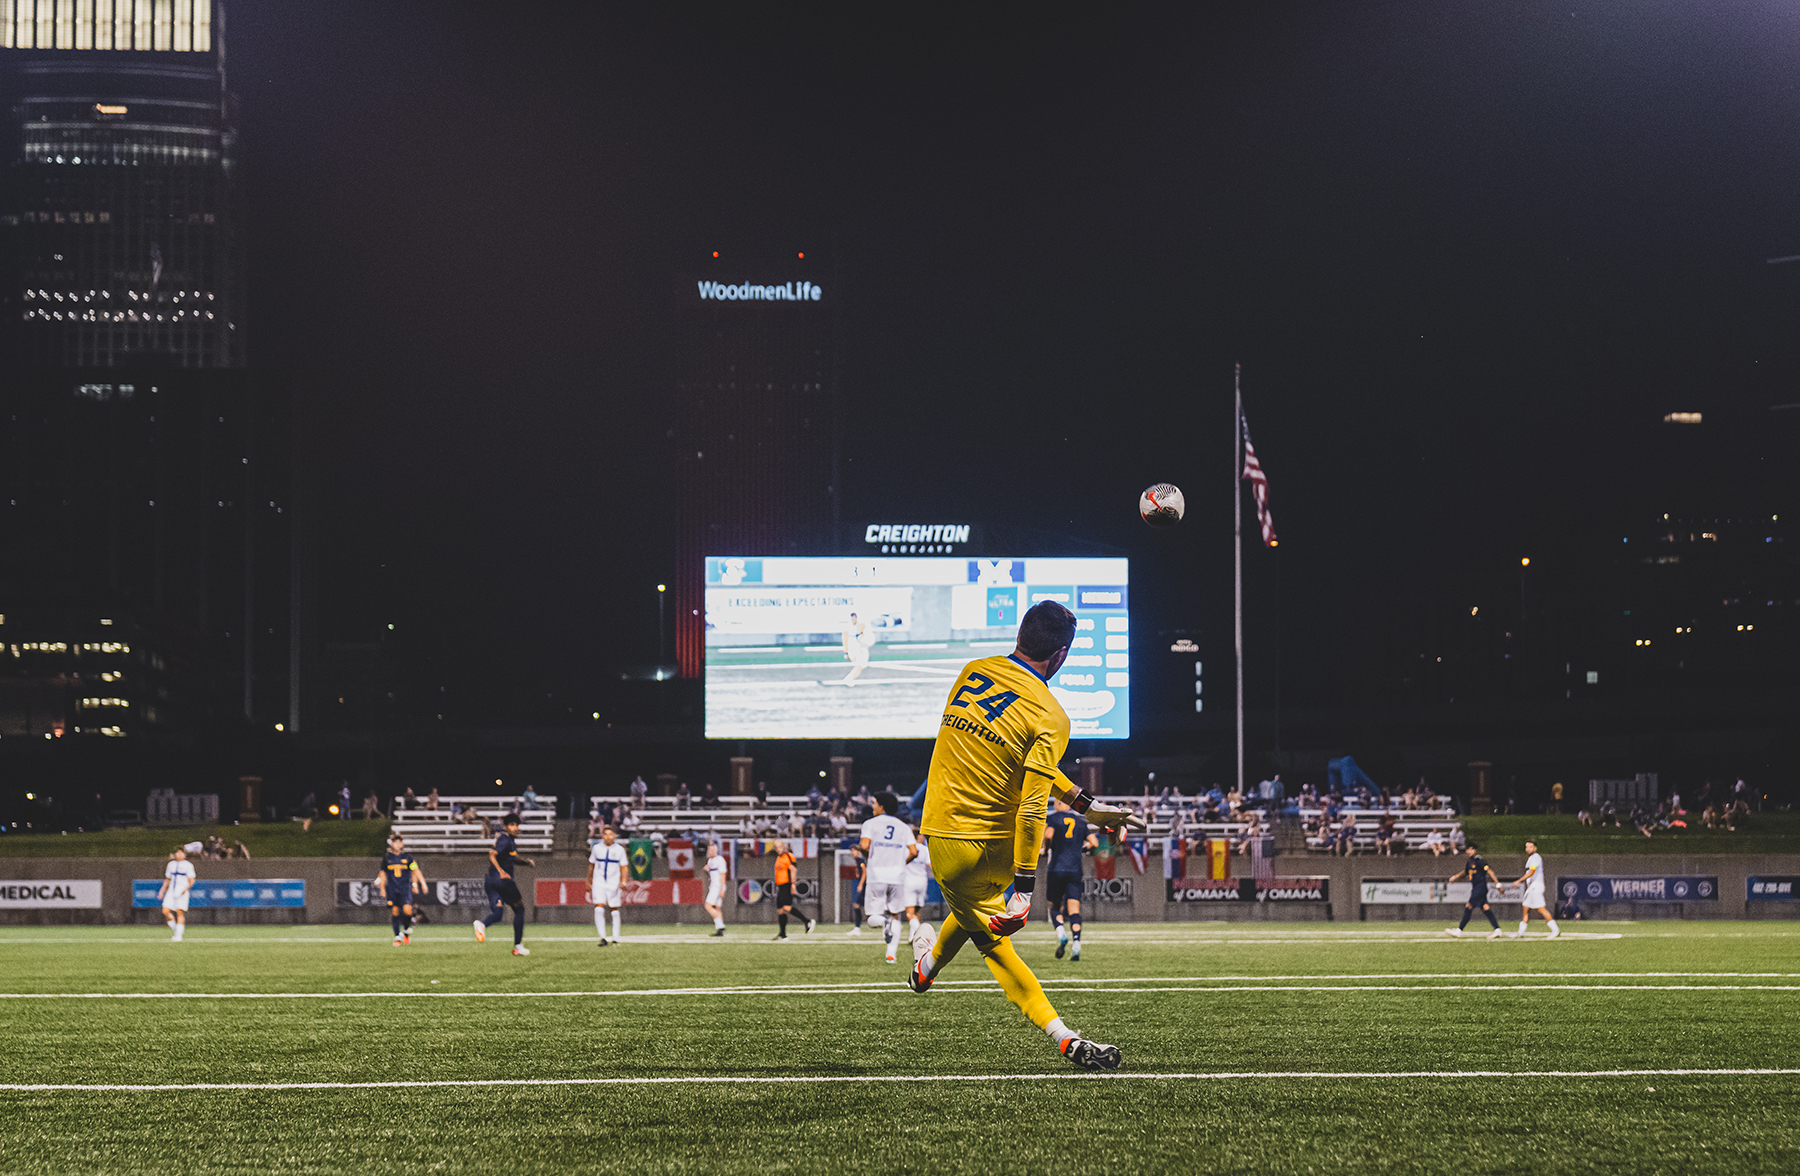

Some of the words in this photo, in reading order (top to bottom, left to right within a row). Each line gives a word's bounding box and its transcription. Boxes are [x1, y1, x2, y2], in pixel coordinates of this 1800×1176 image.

[698, 280, 822, 300] WoodmenLife
[865, 524, 971, 543] CREIGHTON
[950, 671, 1021, 723] 24
[884, 825, 895, 840] 3
[1063, 817, 1076, 839] 7
[1186, 888, 1239, 900] OMAHA
[1269, 888, 1322, 900] OMAHA
[1610, 879, 1665, 894] WERNER
